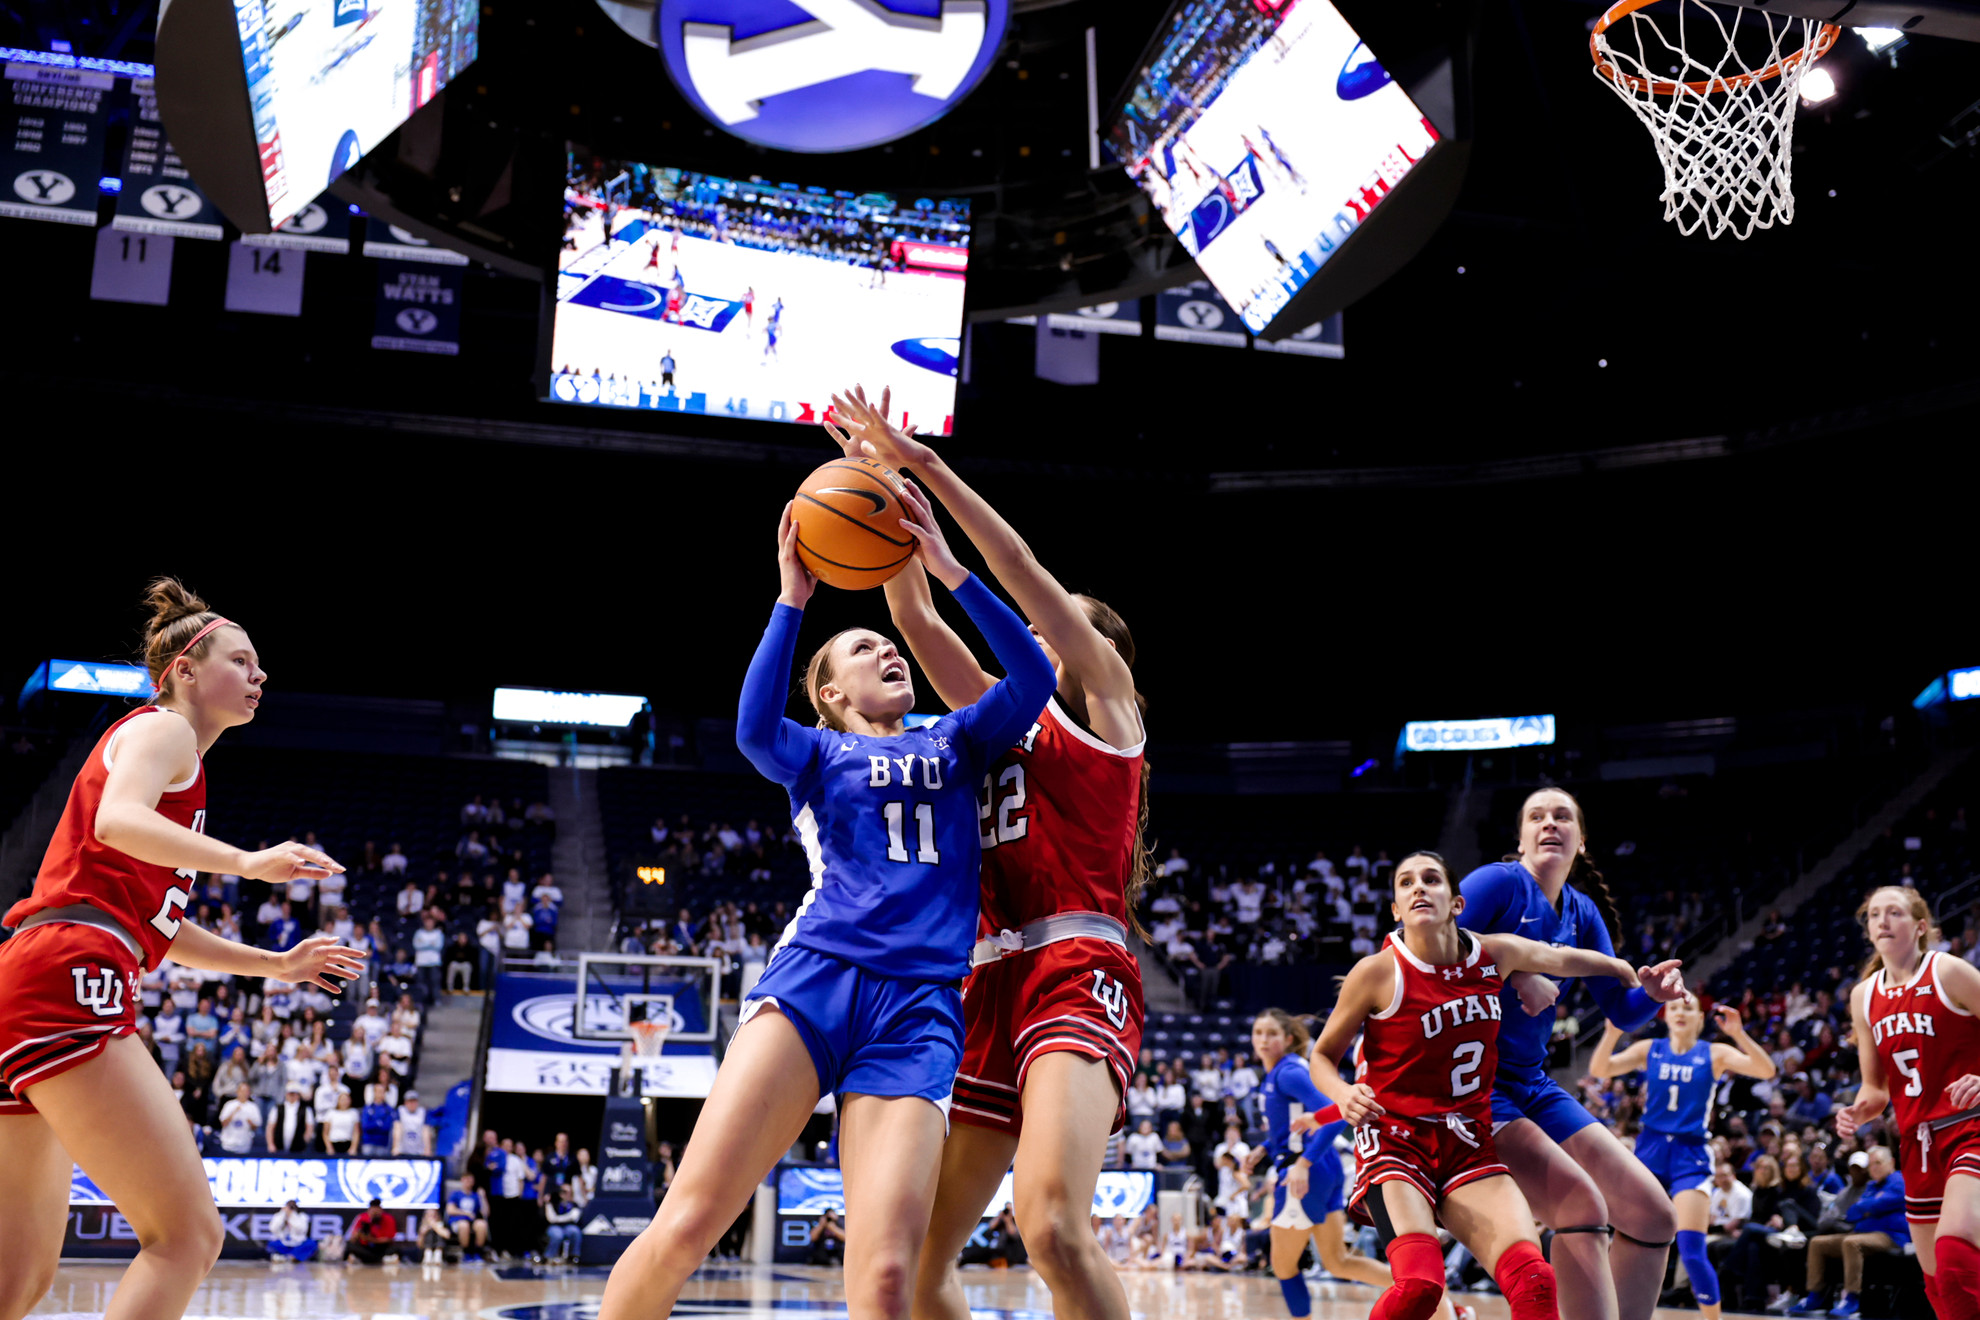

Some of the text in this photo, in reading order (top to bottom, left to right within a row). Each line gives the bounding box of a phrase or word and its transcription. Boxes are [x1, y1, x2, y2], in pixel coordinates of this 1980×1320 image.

[13, 93, 98, 113] CHAMPIONS
[27, 175, 64, 199] Y
[154, 190, 190, 214] Y
[121, 235, 148, 262] 11
[252, 250, 282, 275] 14
[383, 283, 455, 305] WATTS
[867, 753, 943, 790] BYU
[979, 763, 1029, 850] 22
[883, 802, 940, 865] 11
[1420, 994, 1502, 1039] UTAH
[1872, 1012, 1936, 1047] UTAH
[1450, 1040, 1485, 1097] 2
[1659, 1063, 1693, 1083] BYU
[1891, 1048, 1924, 1097] 5
[1667, 1085, 1680, 1112] 1
